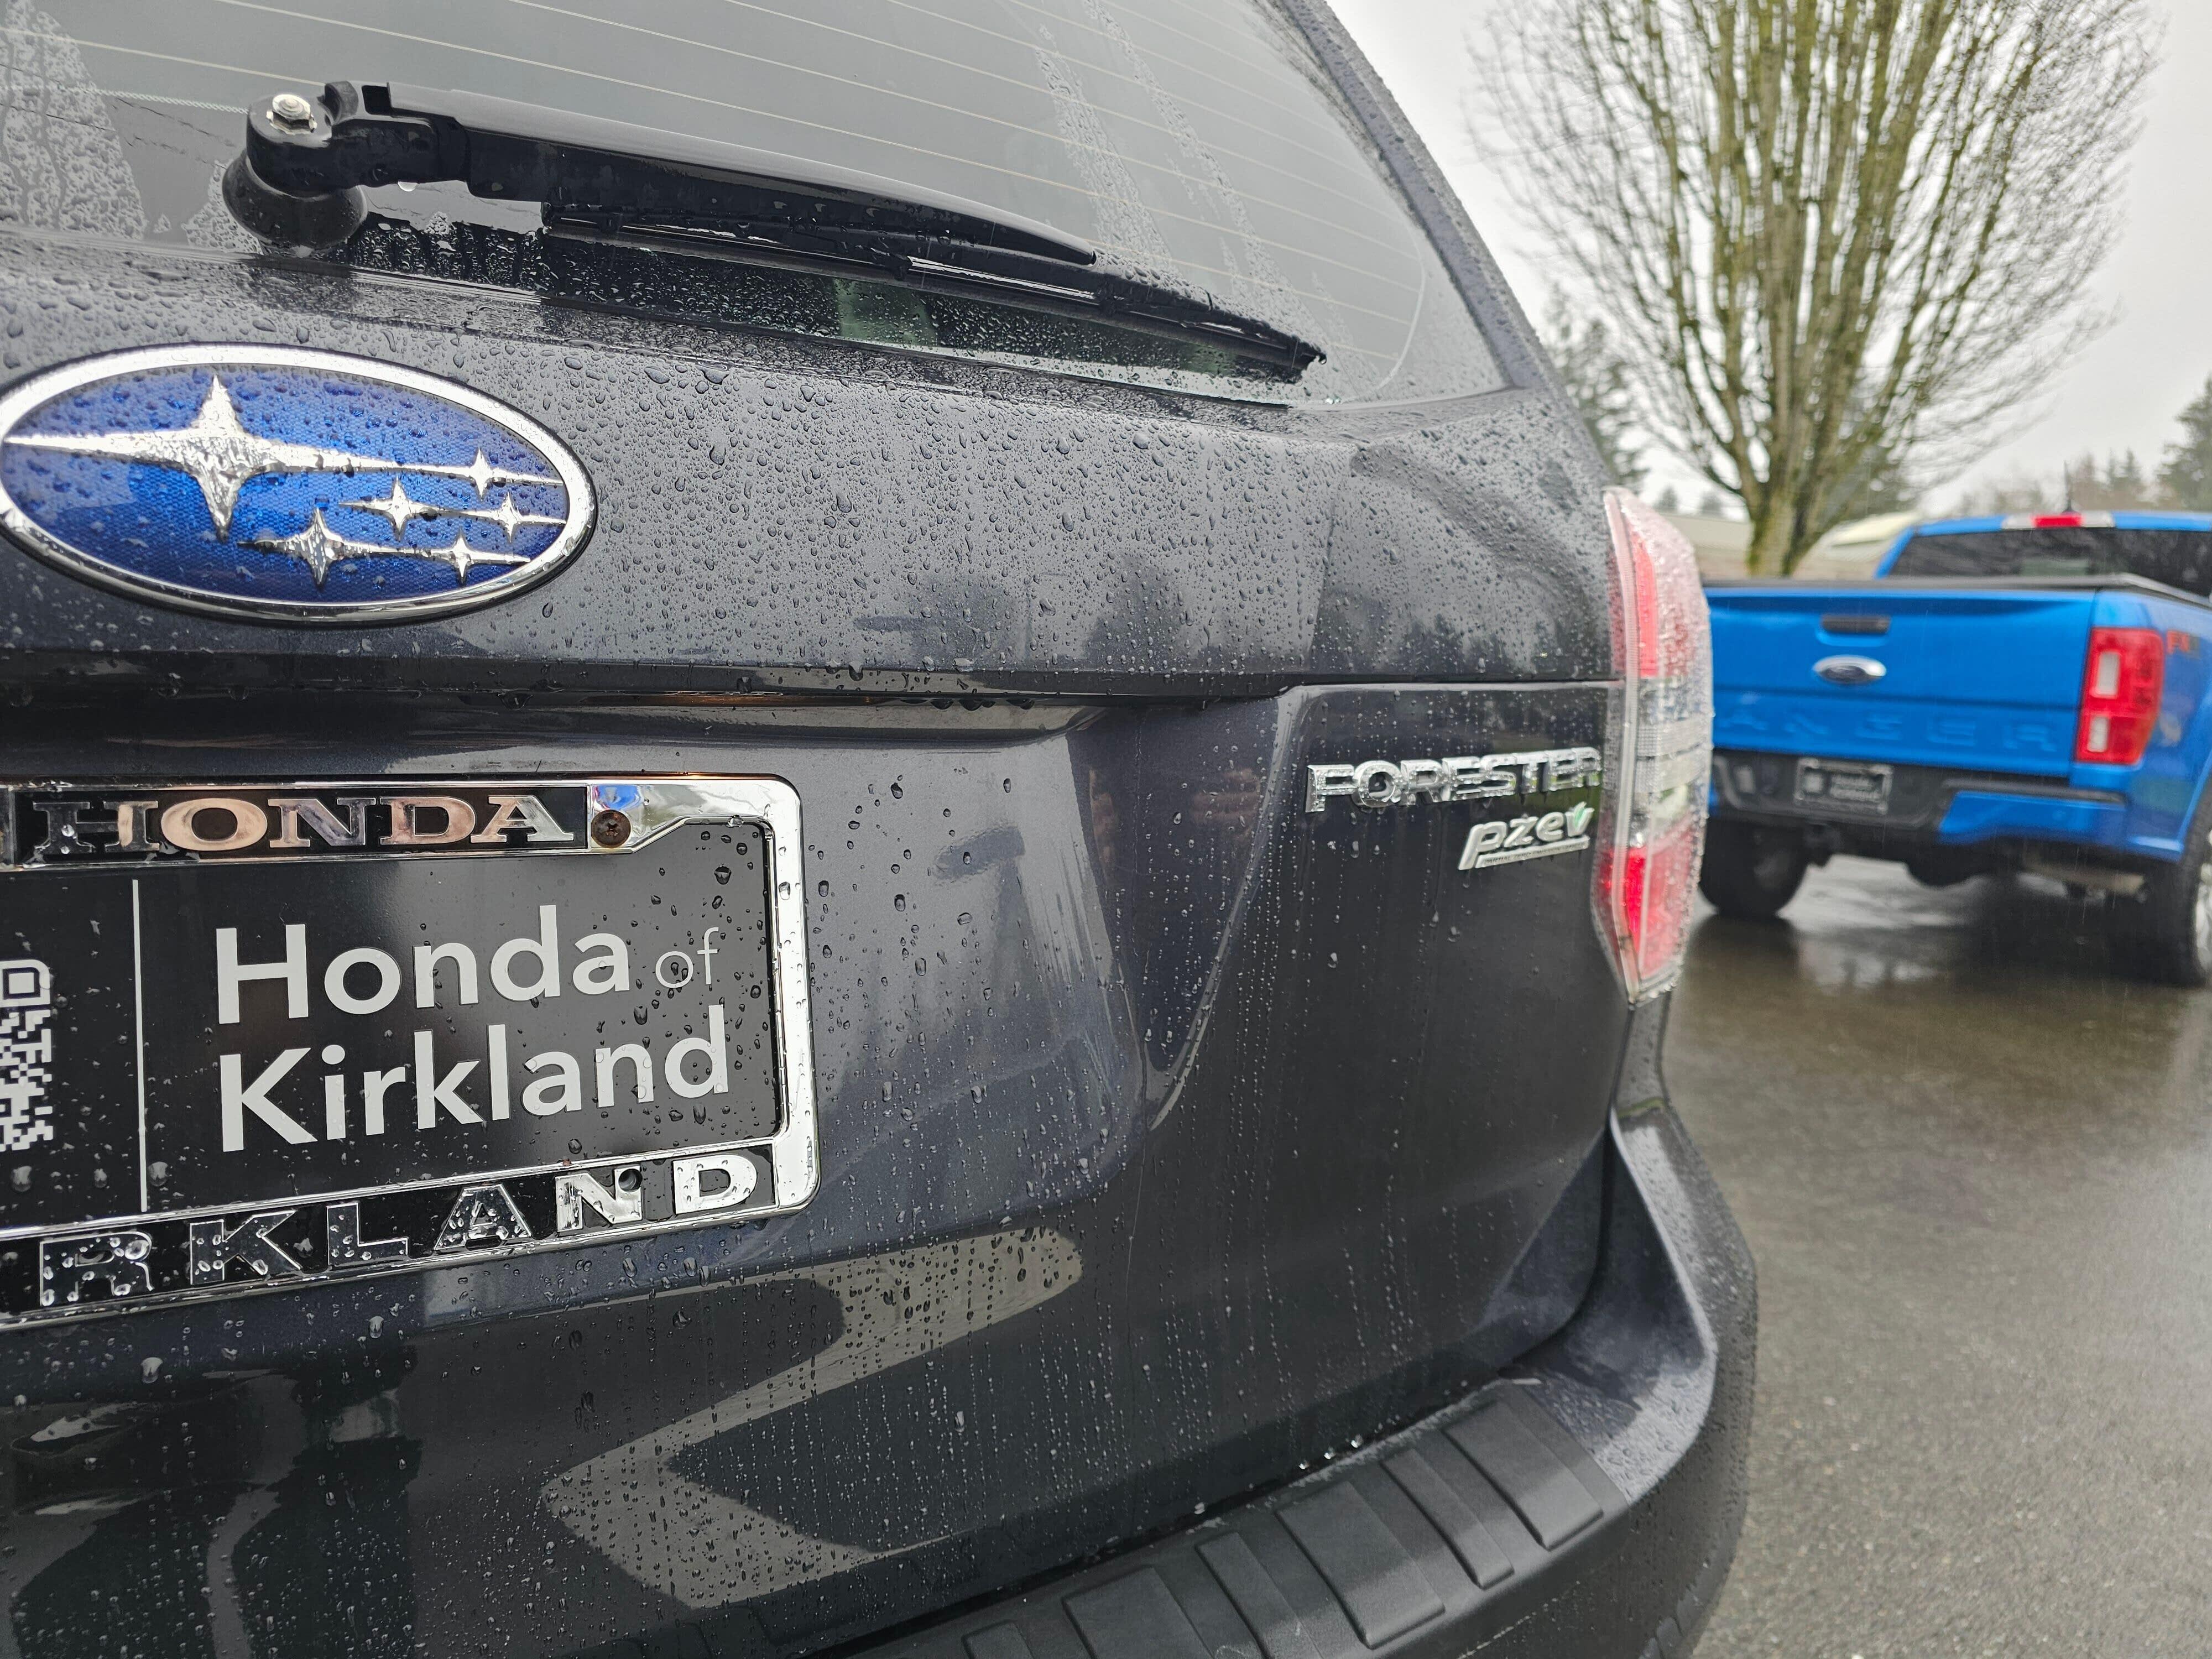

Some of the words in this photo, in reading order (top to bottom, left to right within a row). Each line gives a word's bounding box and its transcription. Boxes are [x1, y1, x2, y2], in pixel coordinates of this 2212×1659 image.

[33, 795, 575, 853] HONDA
[1305, 747, 1602, 812] FORESTER
[1458, 801, 1595, 870] pzev
[216, 905, 630, 1025] Honda
[655, 927, 720, 989] of
[219, 1004, 730, 1152] Kirkland
[39, 1152, 758, 1307] RKLAND
